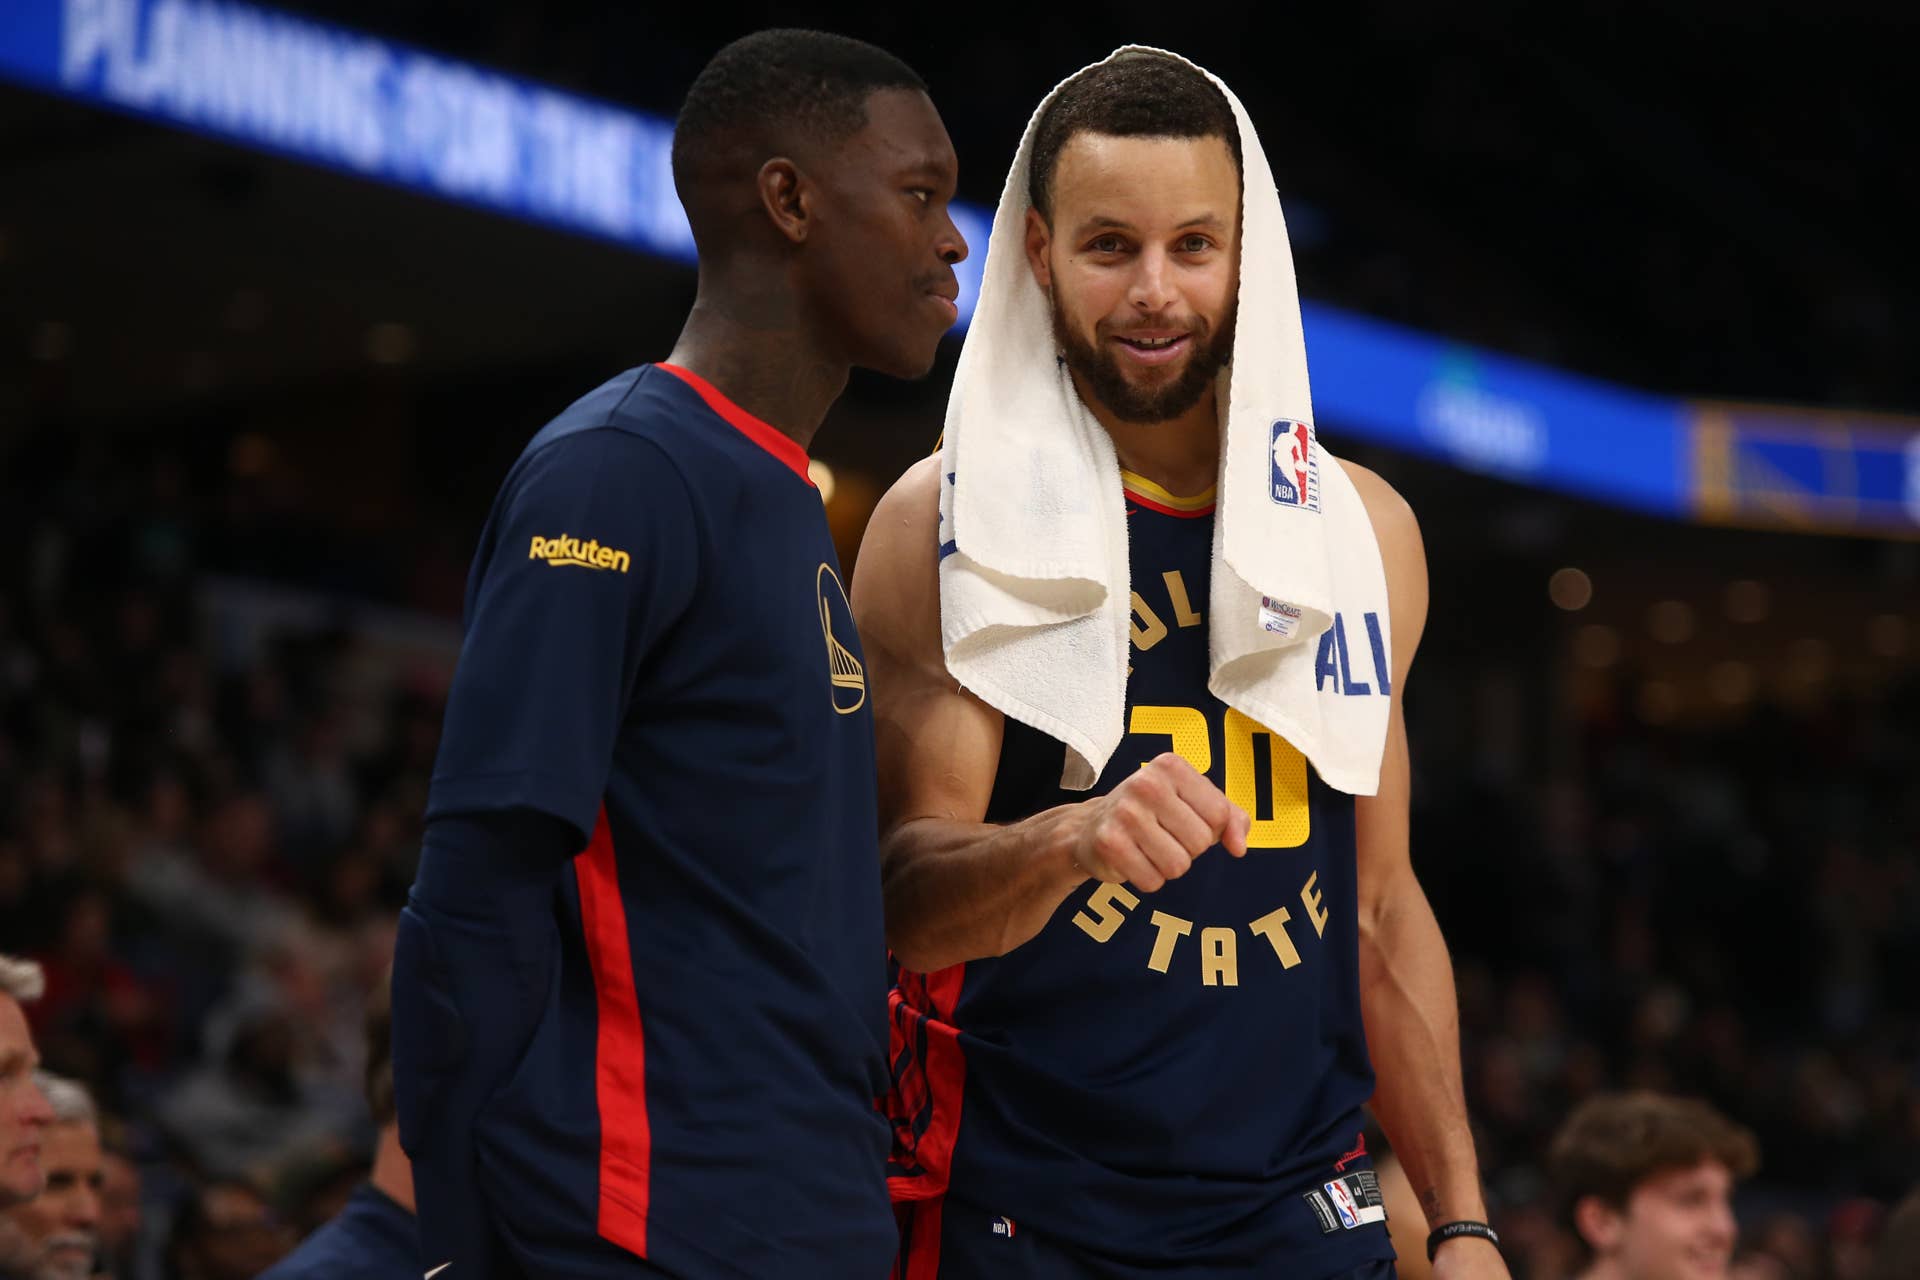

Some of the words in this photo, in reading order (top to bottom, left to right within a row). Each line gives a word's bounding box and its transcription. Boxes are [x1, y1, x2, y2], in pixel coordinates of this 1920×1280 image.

[1275, 484, 1294, 500] NBA
[528, 533, 631, 573] Rakuten
[1071, 869, 1329, 987] STATE
[992, 1222, 1006, 1235] NBA
